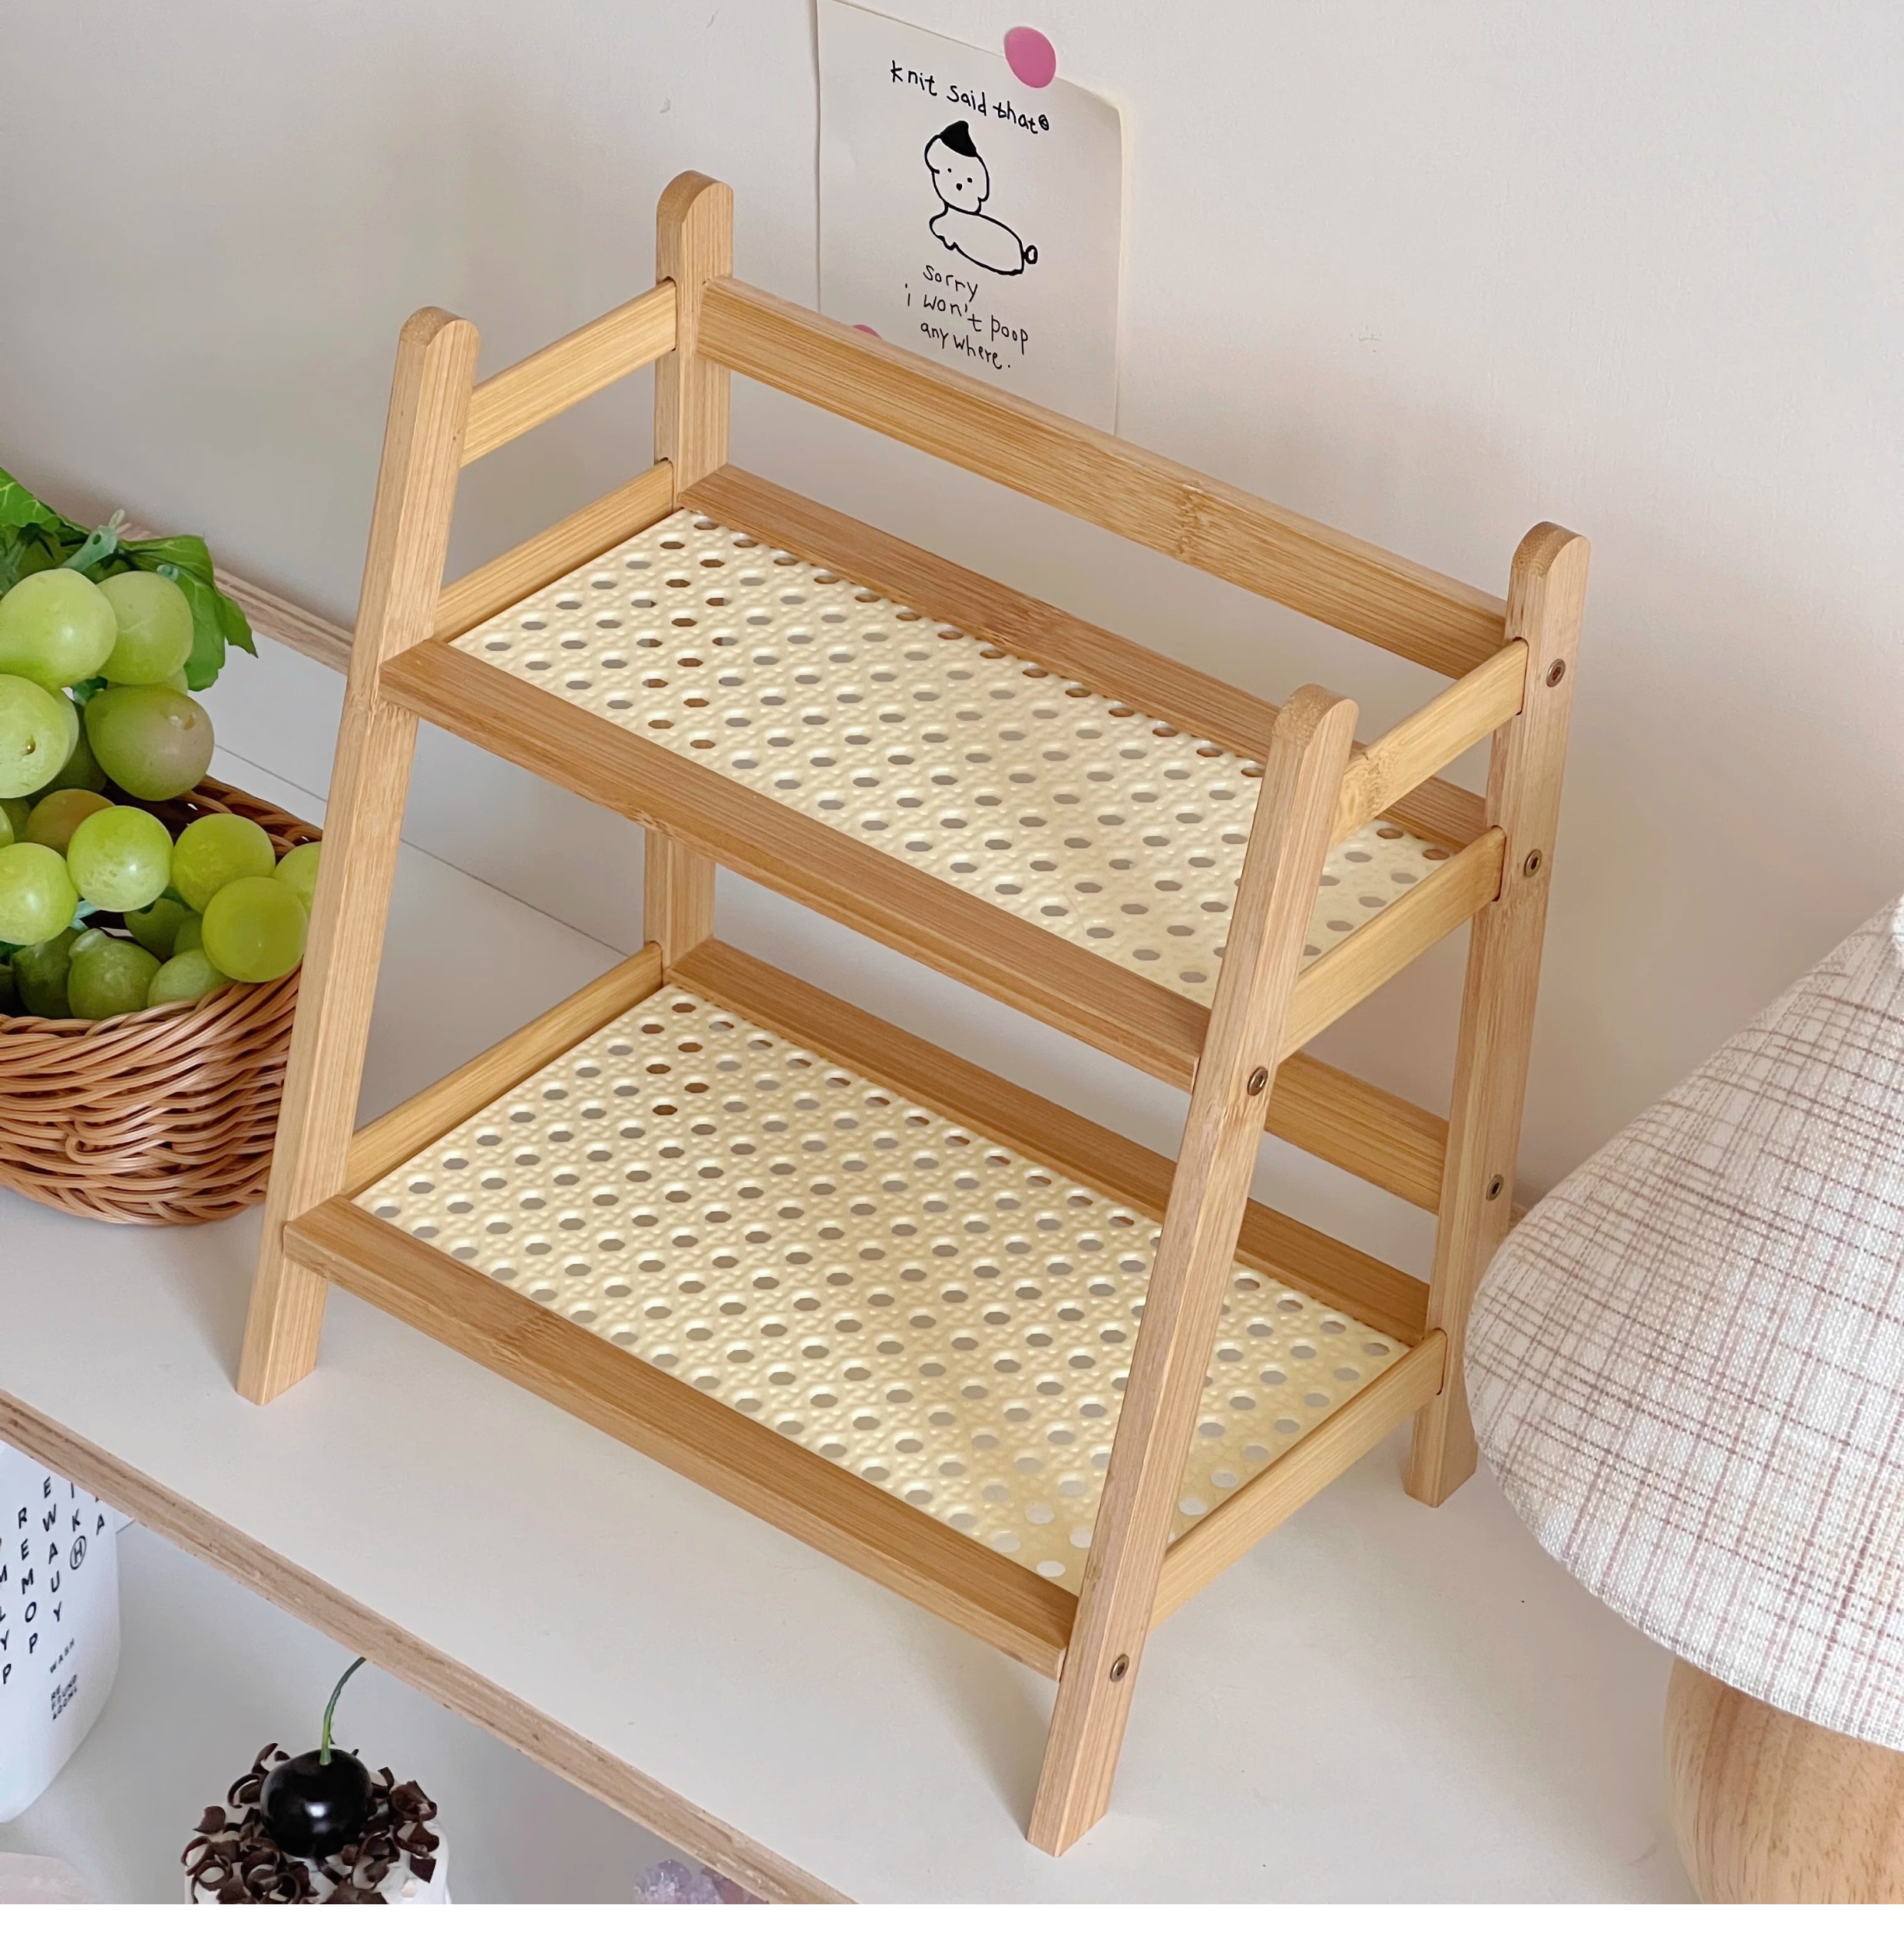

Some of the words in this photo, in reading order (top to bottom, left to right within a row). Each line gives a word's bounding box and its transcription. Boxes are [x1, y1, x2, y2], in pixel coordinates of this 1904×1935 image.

[890, 59, 938, 97] knit
[904, 283, 911, 307] i
[923, 293, 983, 332] won't
[990, 314, 1029, 356] poop
